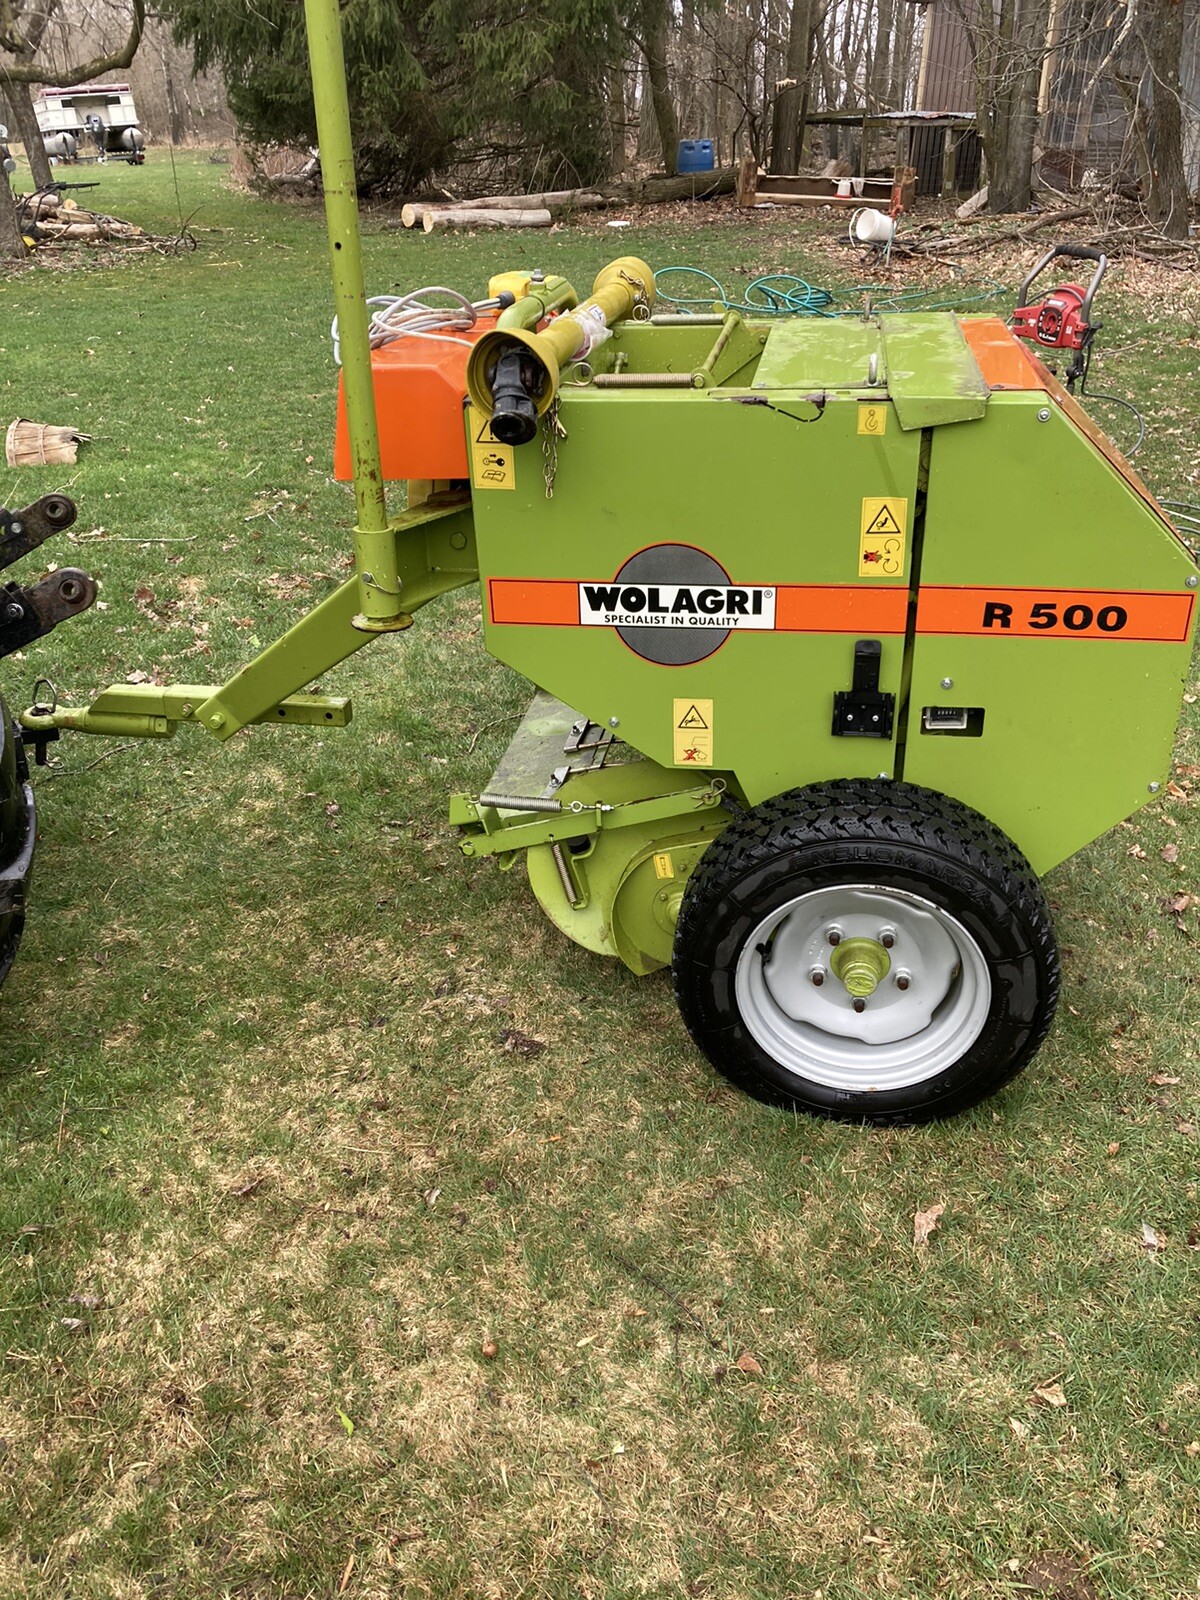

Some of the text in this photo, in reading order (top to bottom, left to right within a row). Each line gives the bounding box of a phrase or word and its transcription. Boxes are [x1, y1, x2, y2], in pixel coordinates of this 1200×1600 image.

[604, 614, 740, 627] SPECIALIST IN QUALITY
[982, 602, 1128, 632] R 500
